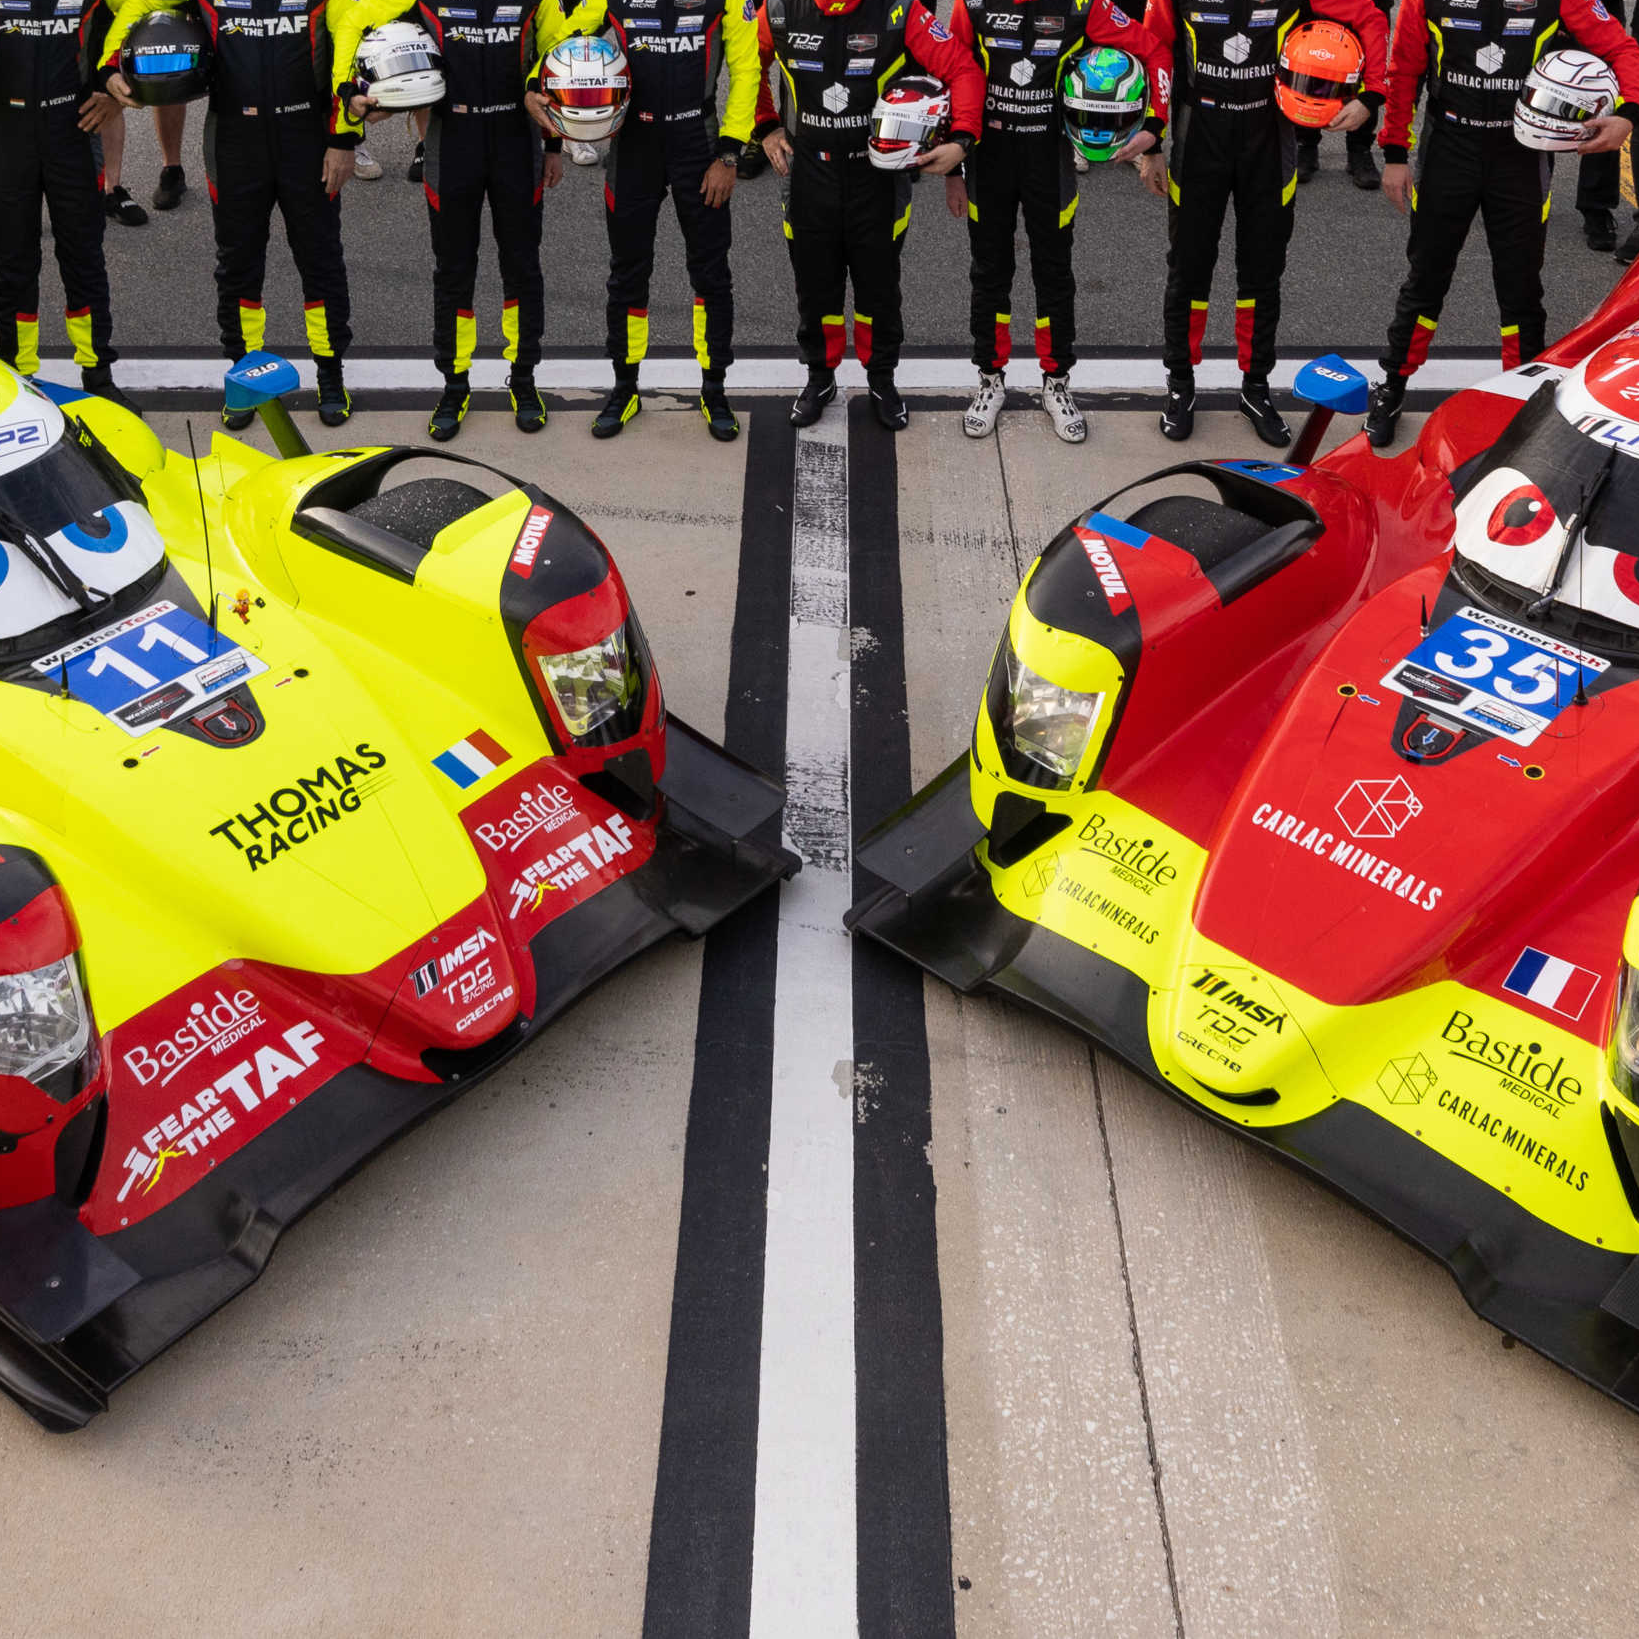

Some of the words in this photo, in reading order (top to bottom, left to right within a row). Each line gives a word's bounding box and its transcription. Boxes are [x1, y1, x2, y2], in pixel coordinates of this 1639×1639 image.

[12, 18, 40, 29] FEAR
[20, 27, 42, 36] THE
[42, 17, 80, 35] TAF
[234, 17, 263, 28] FEAR
[242, 26, 264, 37] THE
[263, 15, 308, 36] TAF
[458, 26, 484, 36] FEAR
[485, 25, 521, 43] TAF
[787, 32, 824, 46] TDS
[986, 13, 1024, 26] TDS
[155, 45, 178, 55] TAF
[408, 42, 429, 53] TAF
[466, 35, 484, 44] THE
[641, 35, 666, 46] FEAR
[648, 45, 667, 54] THE
[666, 34, 706, 53] TAF
[588, 77, 608, 87] TAF
[1197, 61, 1229, 77] CARLAC
[1231, 63, 1276, 79] MINERALS
[1447, 72, 1479, 87] CARLAC
[801, 112, 832, 127] CARLAC
[998, 102, 1053, 114] CHEMDIRECT
[514, 514, 551, 566] MOTUL
[1082, 539, 1128, 598] MOTUL
[37, 602, 172, 669] WeatherTech
[1466, 607, 1604, 669] WeatherTech
[86, 621, 210, 690] 11
[1434, 629, 1578, 705] 35
[210, 743, 387, 850] THOMAS
[245, 788, 362, 872] RACING
[475, 782, 575, 853] Bastide
[522, 846, 576, 885] FEAR
[573, 814, 634, 881] TAF
[1078, 814, 1177, 887] Bastide
[1251, 802, 1335, 858] CARLAC
[1329, 840, 1443, 912] MINERALS
[550, 862, 589, 892] THE
[1058, 876, 1098, 910] CARLAC
[1097, 901, 1160, 945] MINERALS
[440, 929, 497, 973] IMSA
[442, 958, 494, 1004] TDS
[462, 975, 497, 1004] RACING
[1196, 1004, 1258, 1047] TDS
[1219, 990, 1286, 1034] IMSA
[122, 989, 261, 1088] Bastide
[1176, 1030, 1228, 1066] ORECA
[1441, 1009, 1583, 1105] Bastide
[216, 1021, 326, 1113] TAF
[1499, 1077, 1563, 1120] MEDICAL
[142, 1088, 220, 1154] FEAR
[177, 1106, 236, 1157] THE
[1438, 1089, 1502, 1139] CARLAC
[1502, 1131, 1590, 1193] MINERALS
